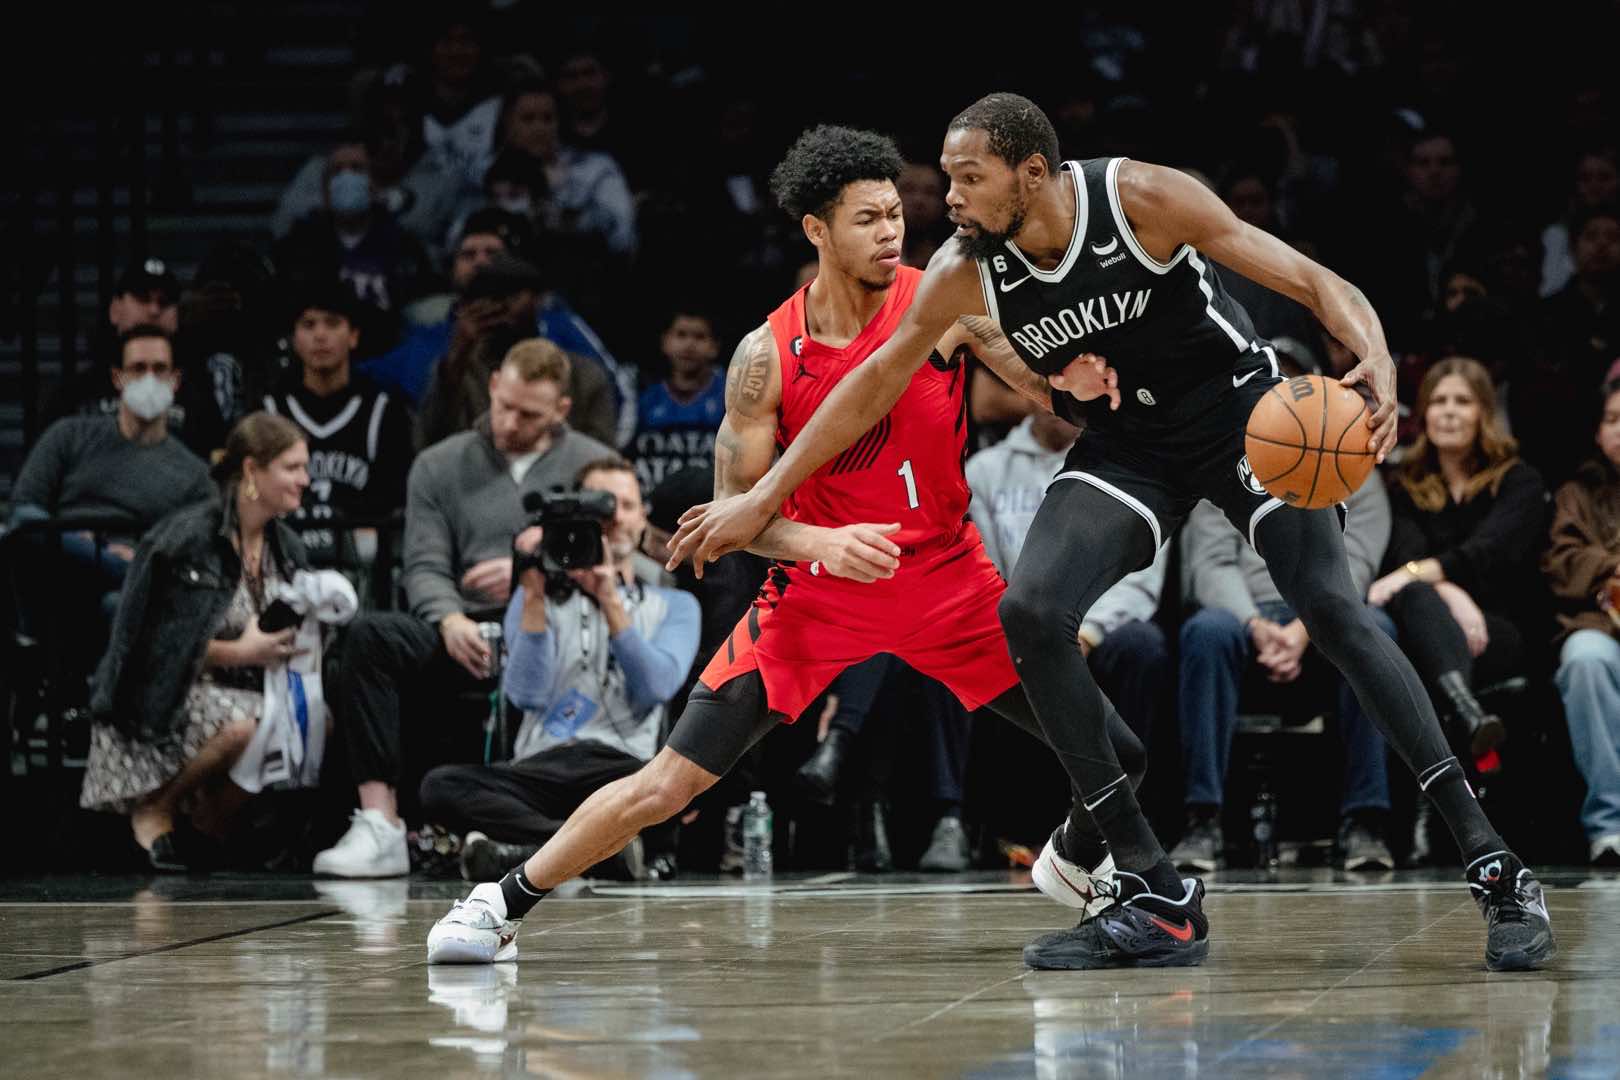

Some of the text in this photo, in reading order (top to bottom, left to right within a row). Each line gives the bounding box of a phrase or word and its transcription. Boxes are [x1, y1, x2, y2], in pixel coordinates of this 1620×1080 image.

[992, 254, 1009, 273] 6
[1099, 252, 1126, 268] Webull
[1011, 288, 1152, 360] BROOKLYN
[897, 459, 920, 509] 1
